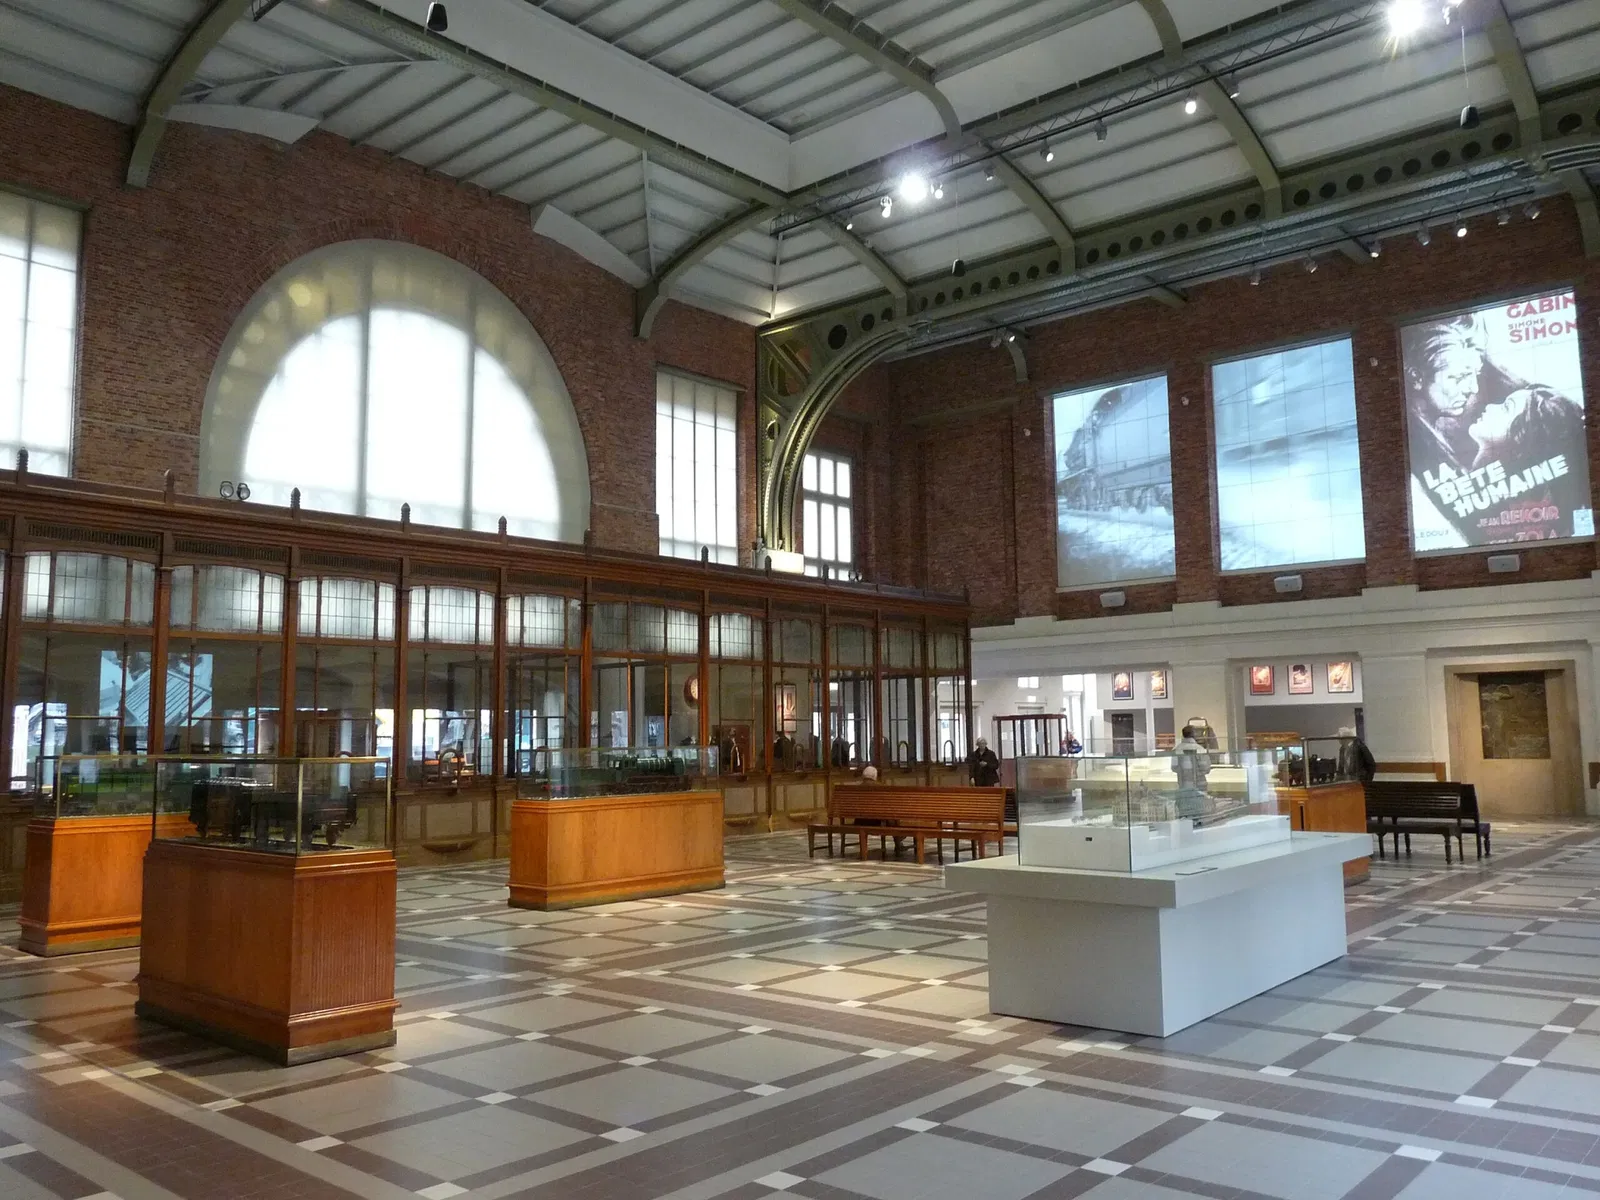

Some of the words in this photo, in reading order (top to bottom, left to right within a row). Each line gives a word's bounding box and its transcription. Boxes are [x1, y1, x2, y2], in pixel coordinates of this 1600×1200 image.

[1506, 295, 1575, 318] GABIN
[1508, 318, 1545, 330] SIMONE
[1509, 320, 1577, 343] SIMON
[1423, 462, 1458, 489] LA
[1453, 454, 1569, 518] HUMAINE
[1500, 505, 1559, 525] RENOIR
